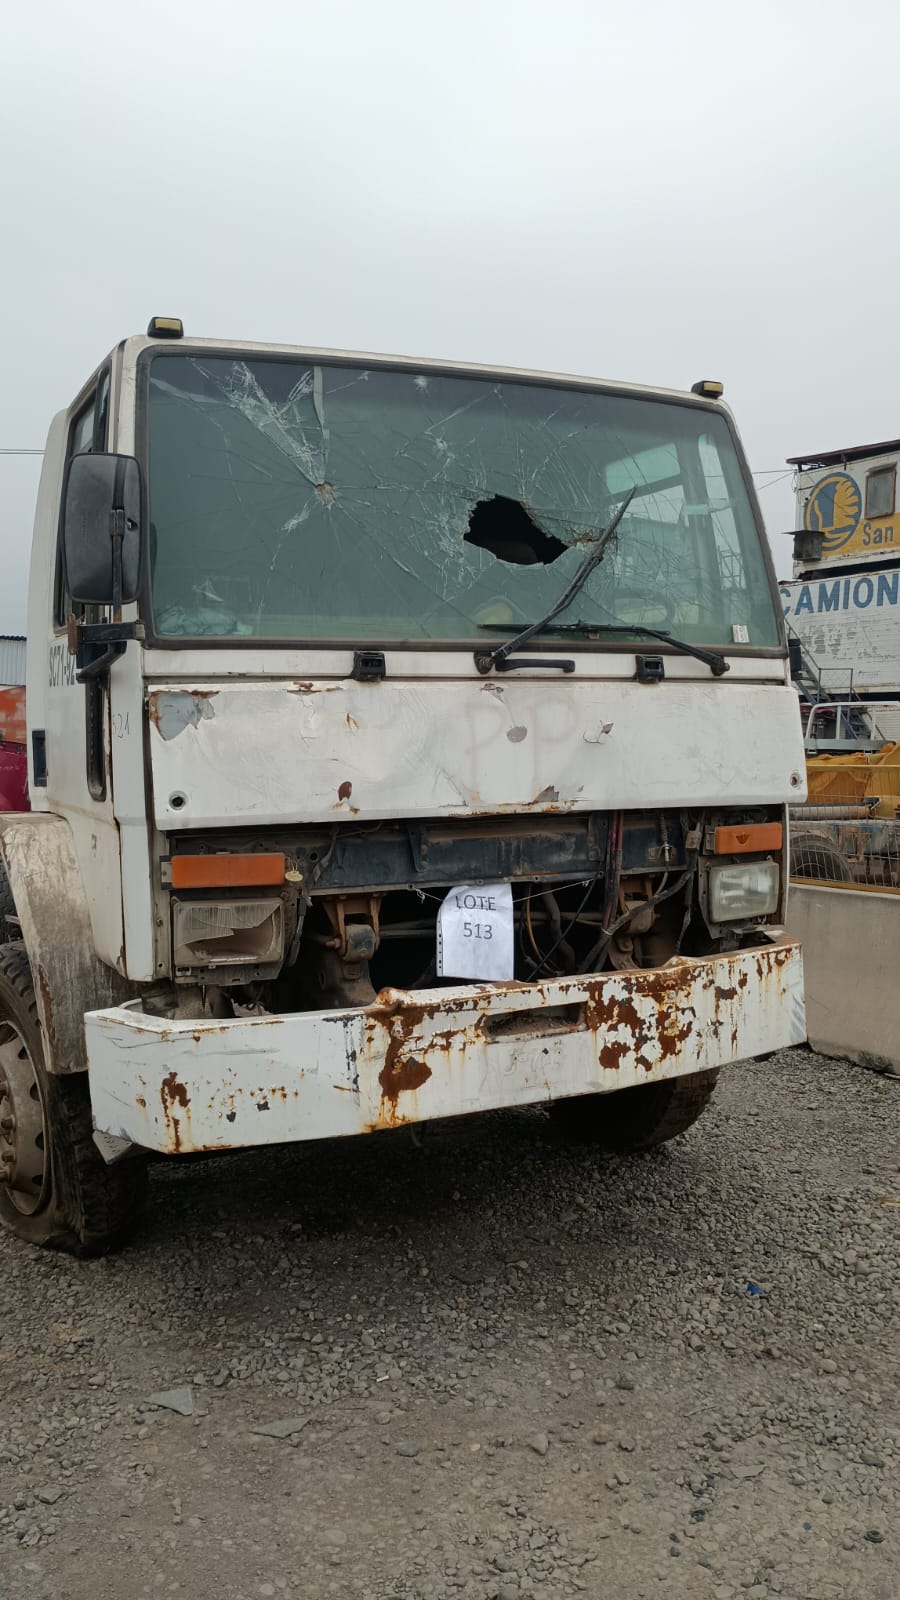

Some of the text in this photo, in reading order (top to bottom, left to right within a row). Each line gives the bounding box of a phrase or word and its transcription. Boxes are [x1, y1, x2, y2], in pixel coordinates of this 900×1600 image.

[863, 522, 894, 546] San
[455, 894, 497, 911] LOTE
[463, 922, 493, 940] 513
